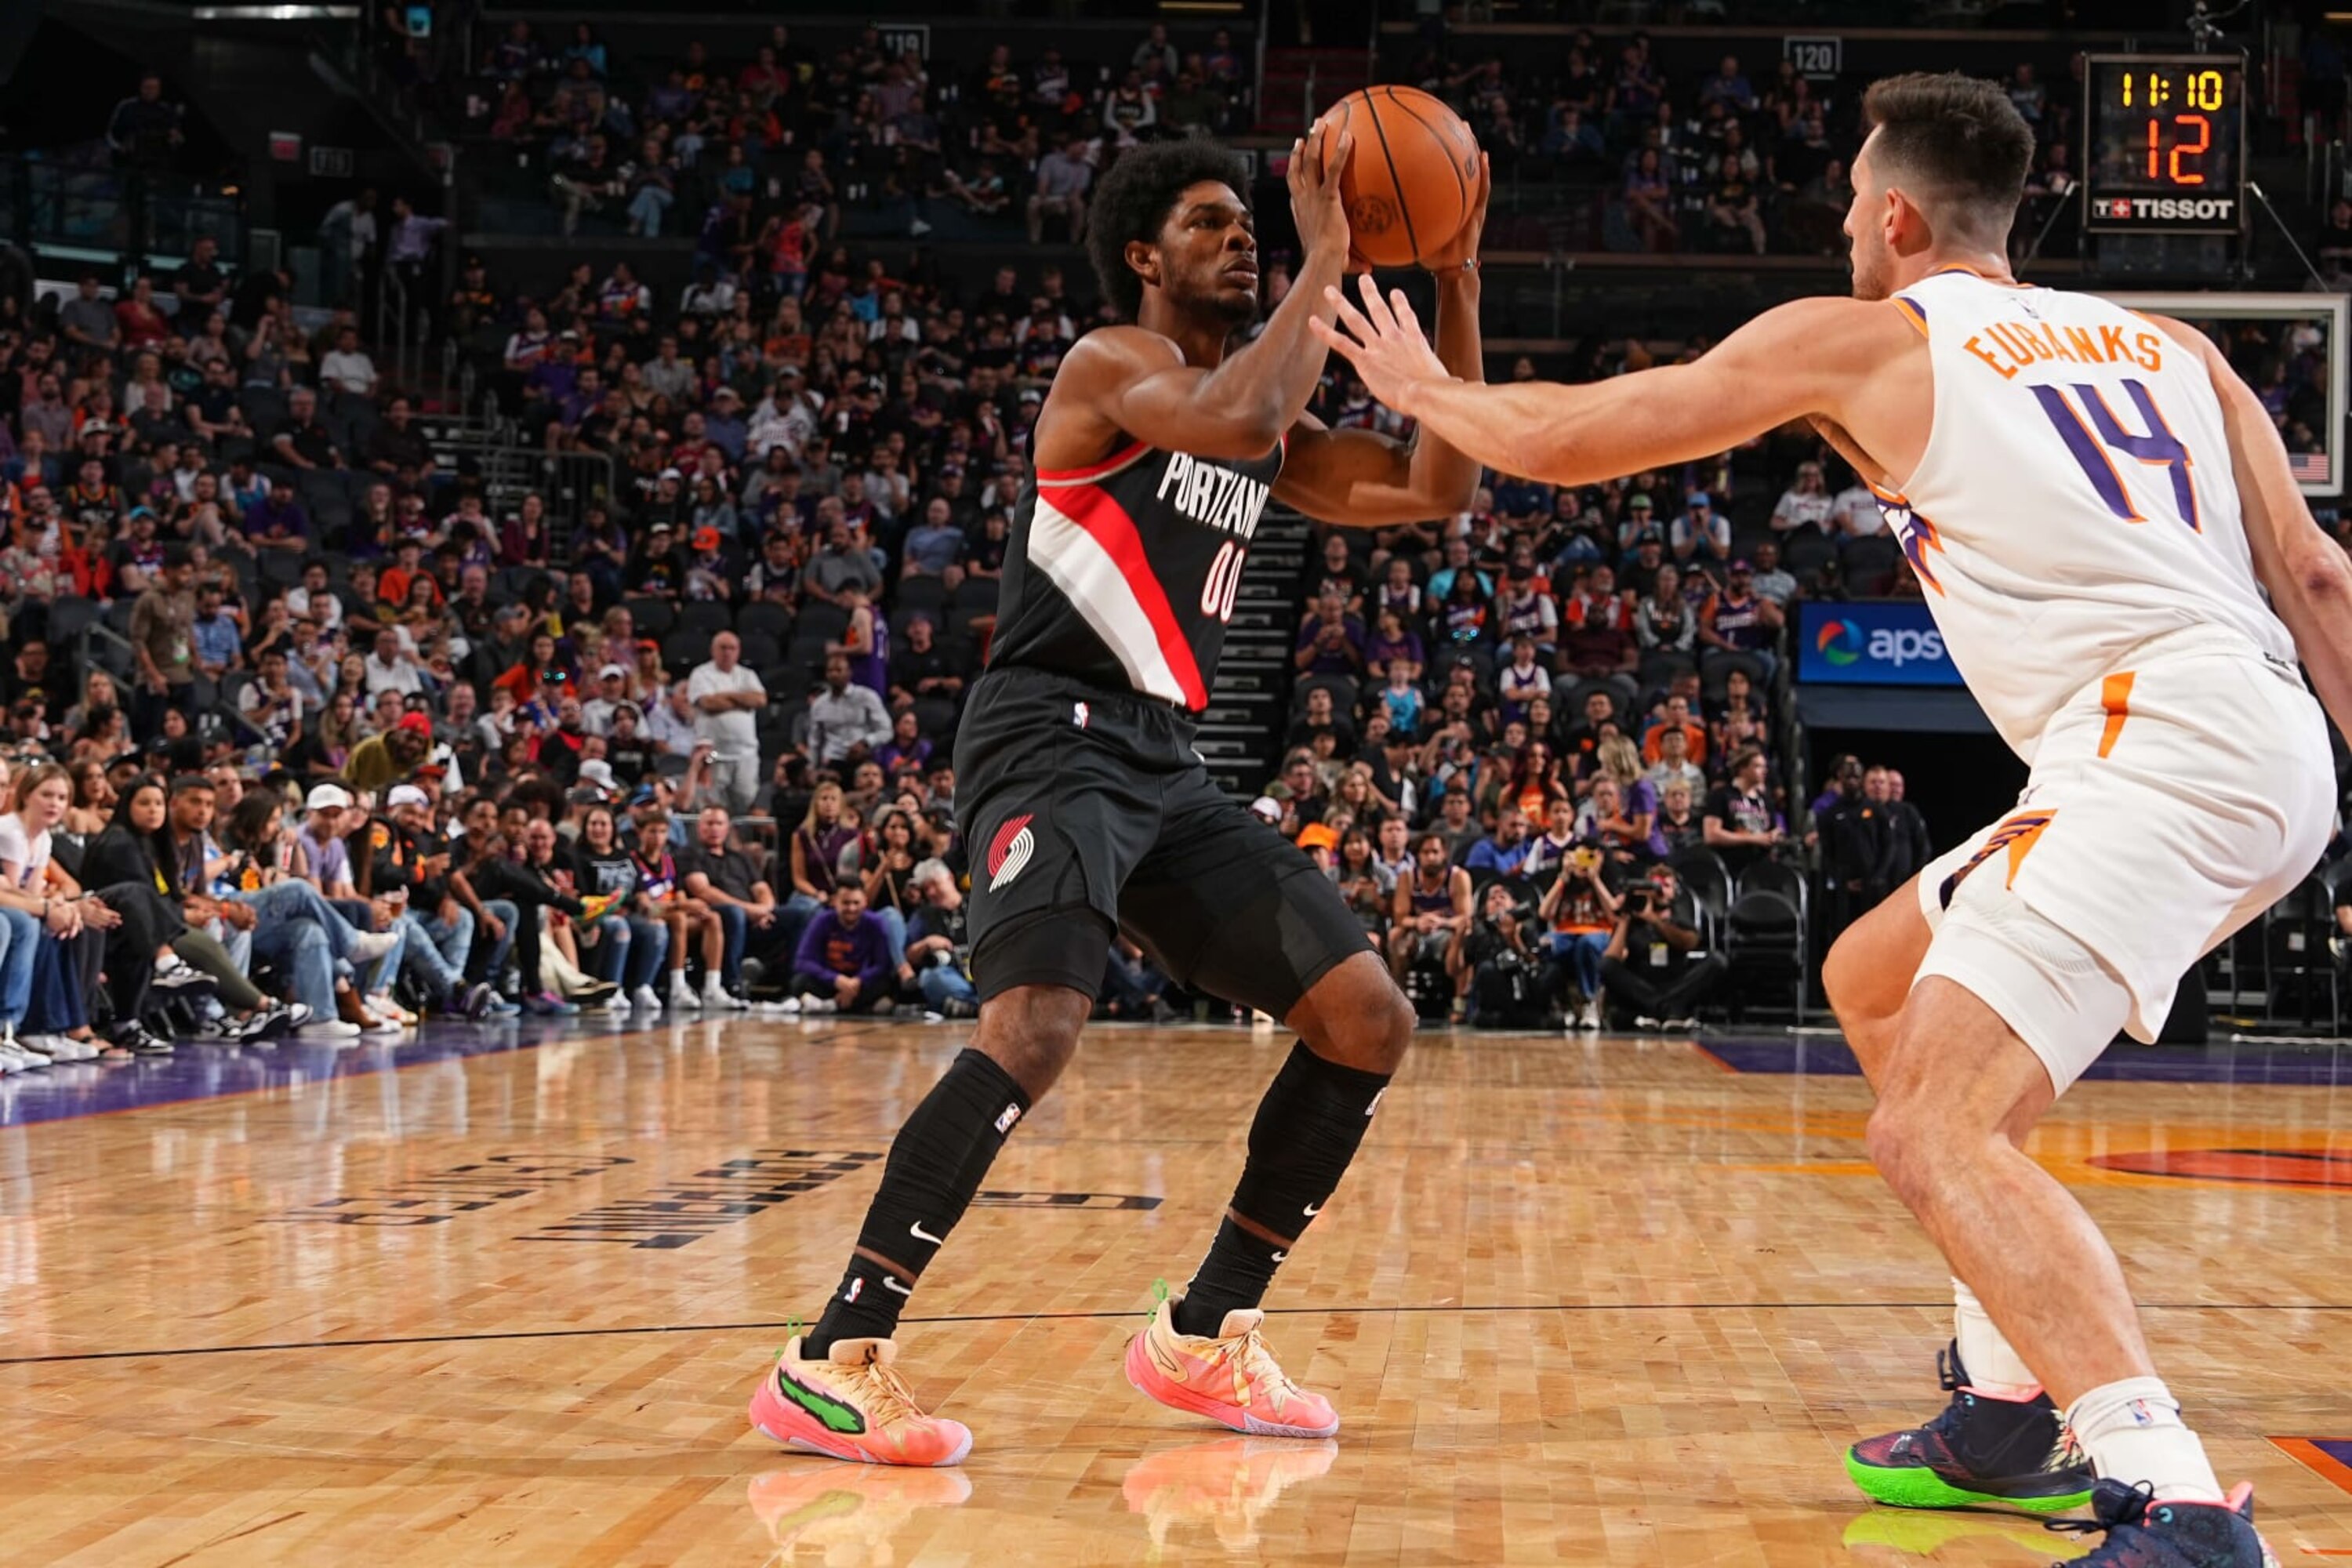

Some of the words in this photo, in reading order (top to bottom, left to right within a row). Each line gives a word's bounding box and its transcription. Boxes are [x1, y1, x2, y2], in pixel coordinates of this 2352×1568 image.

[1795, 45, 1832, 71] 120
[2123, 71, 2223, 111] 11:10
[2148, 115, 2210, 183] 12
[2132, 199, 2234, 220] TISSOT
[1963, 322, 2161, 380] EUBANKS
[2025, 379, 2202, 535] 14
[1156, 451, 1271, 540] PORTLAN
[1201, 539, 1246, 622] 00
[1868, 629, 1944, 666] aps
[252, 1155, 636, 1226] CENTER
